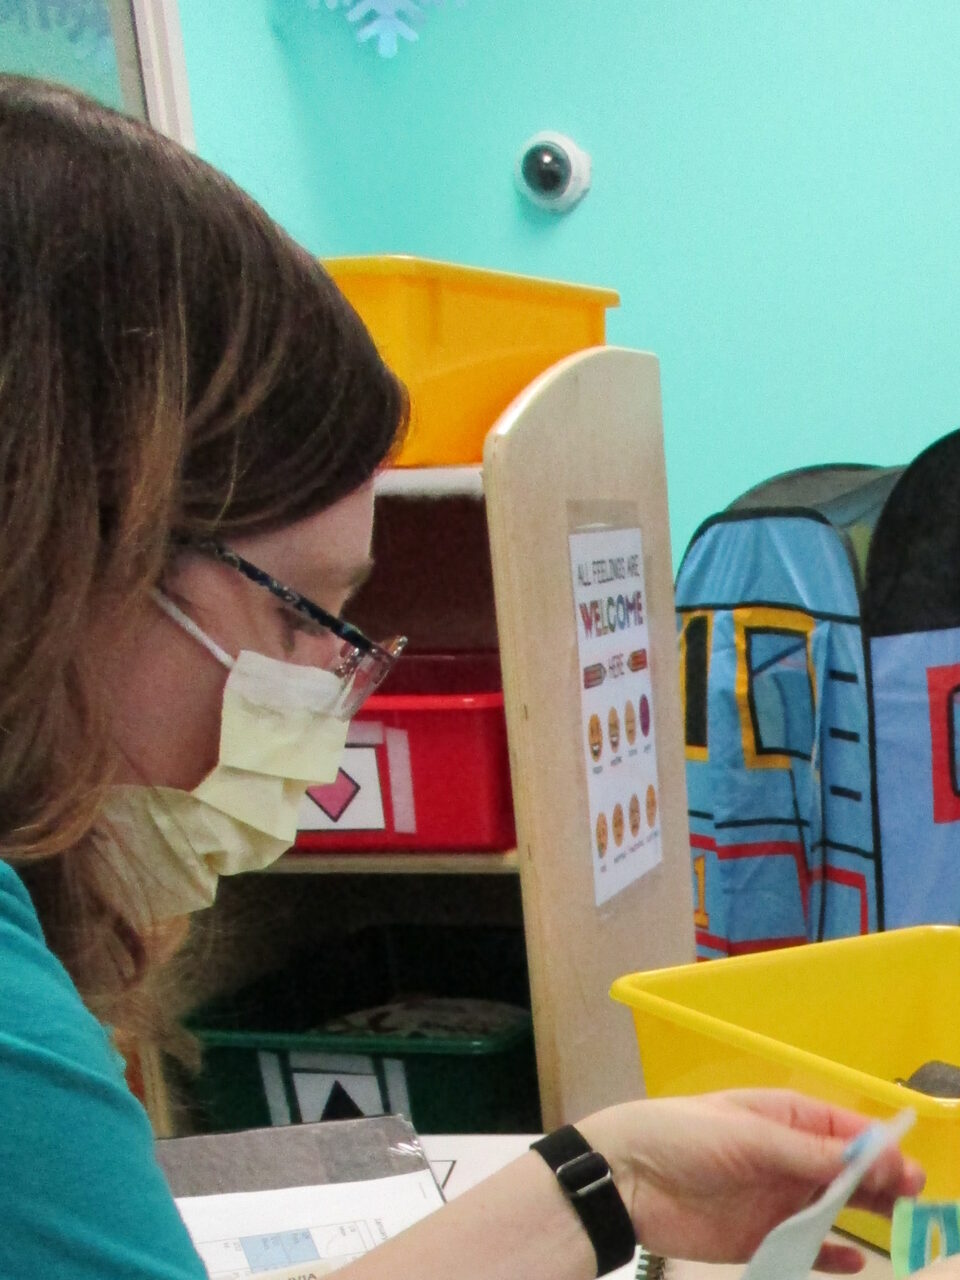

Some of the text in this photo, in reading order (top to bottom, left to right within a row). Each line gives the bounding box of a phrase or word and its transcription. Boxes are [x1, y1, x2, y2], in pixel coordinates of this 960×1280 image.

[578, 554, 640, 586] ALL FEELINGS ARE
[579, 590, 643, 639] WELCOME
